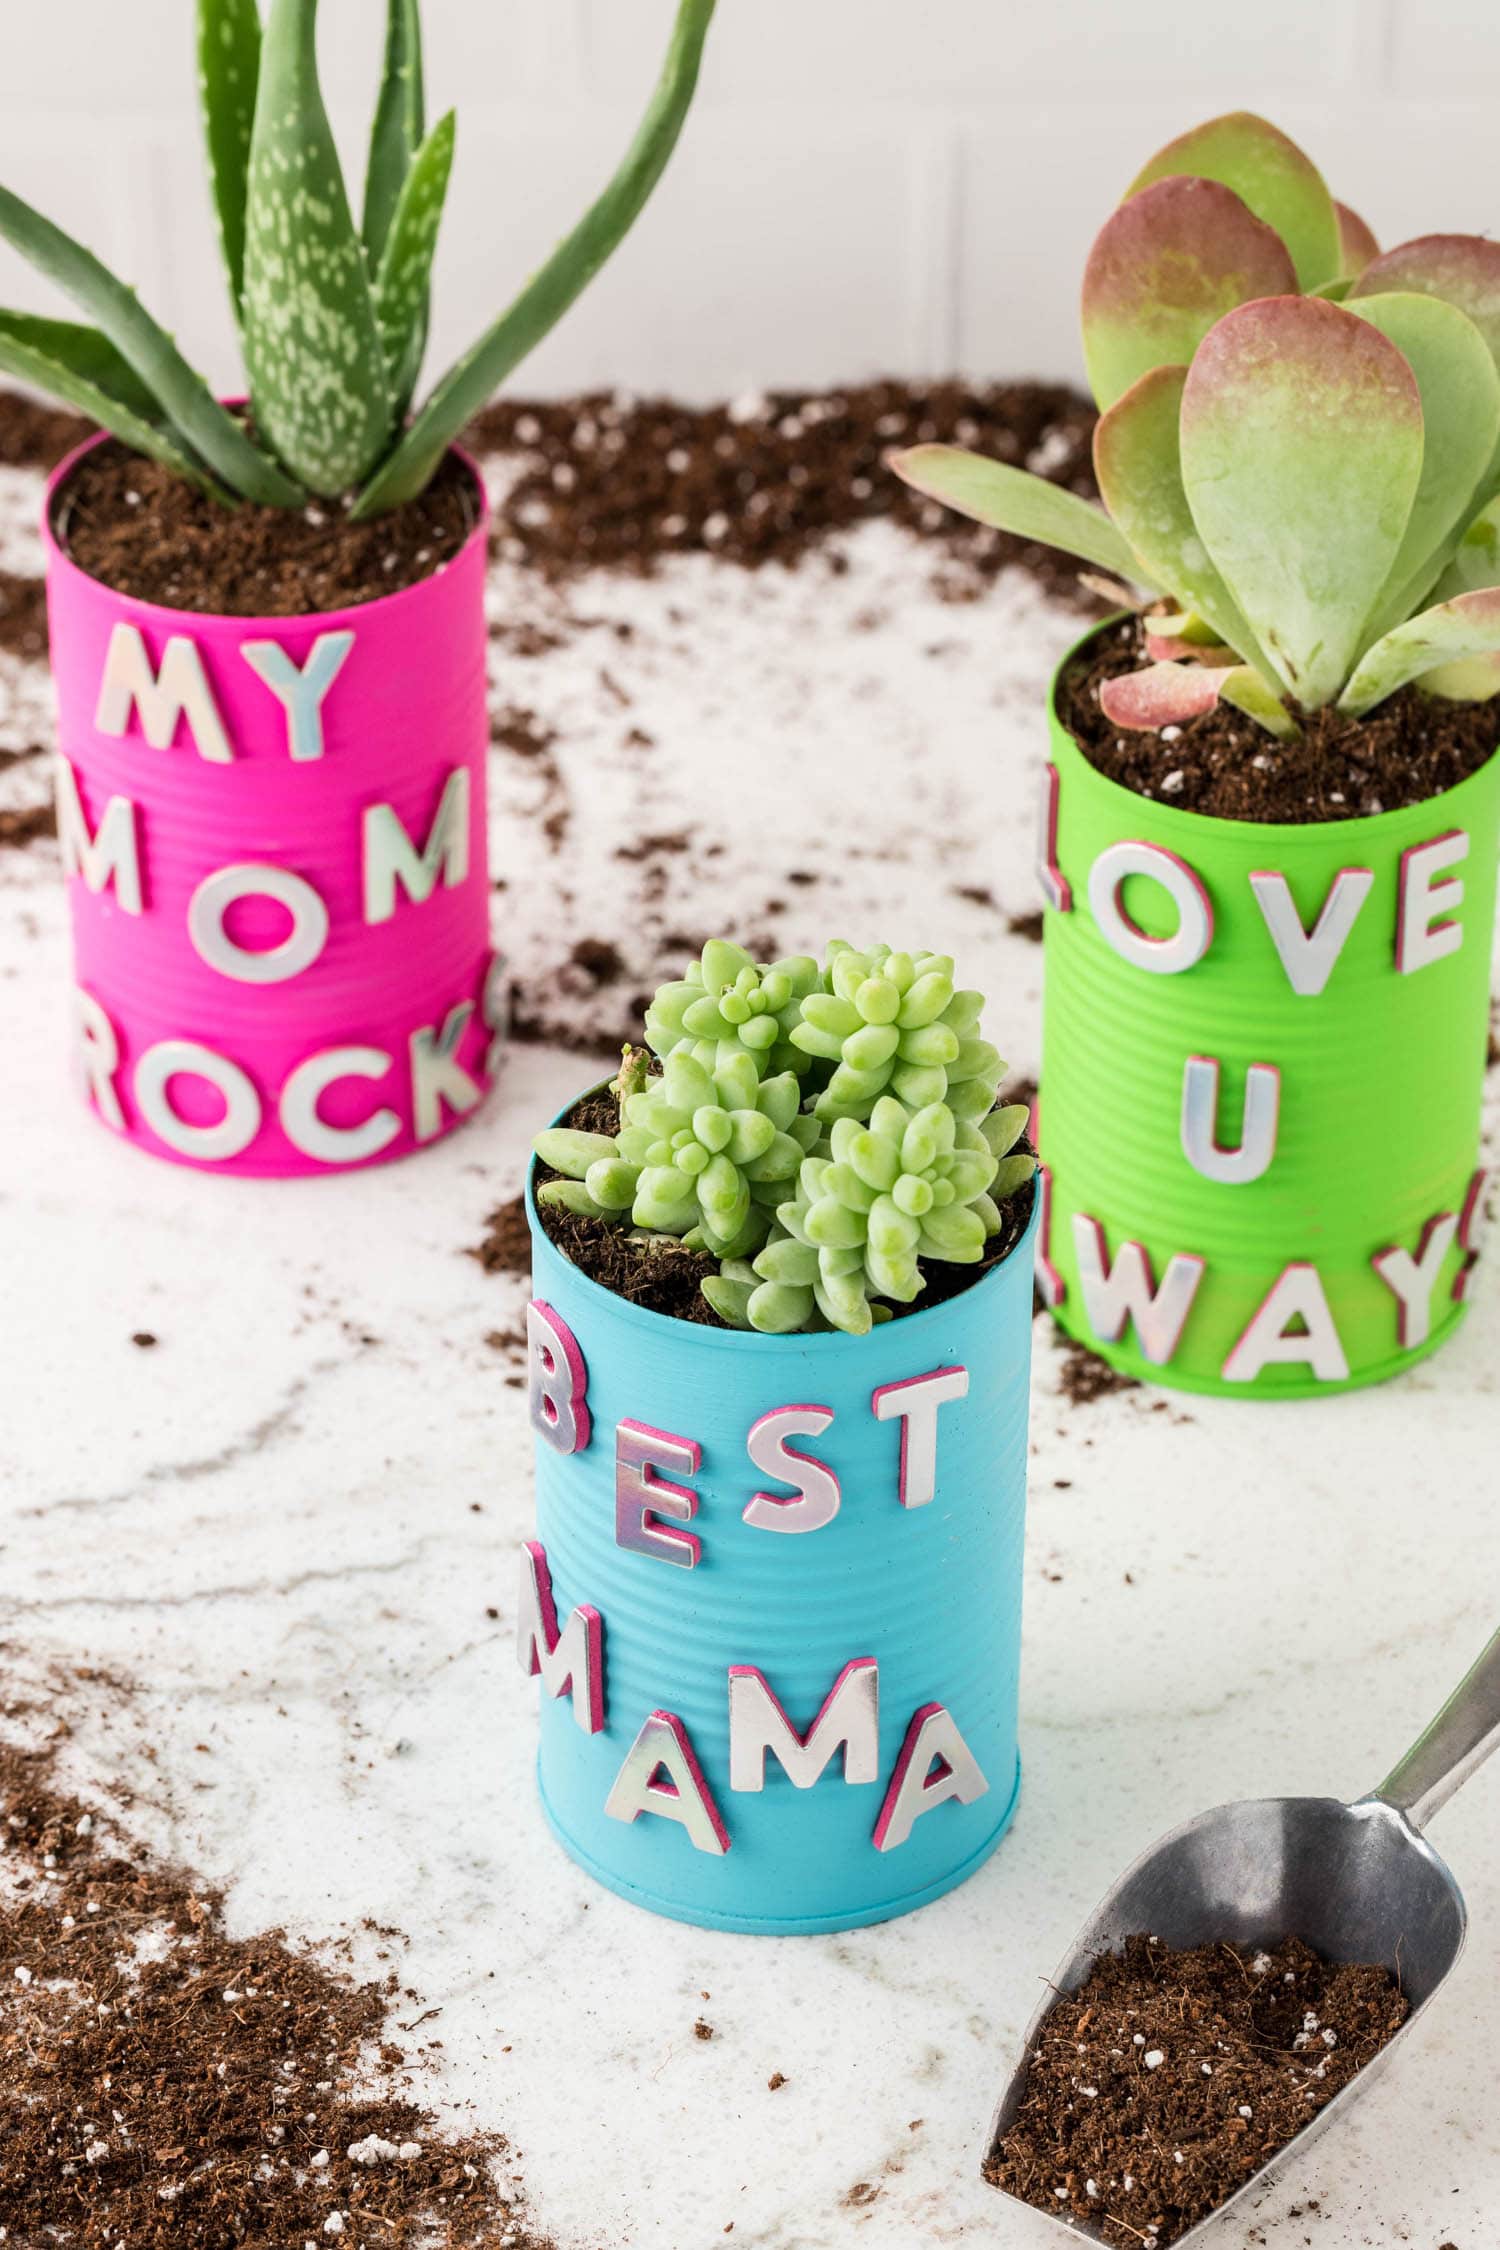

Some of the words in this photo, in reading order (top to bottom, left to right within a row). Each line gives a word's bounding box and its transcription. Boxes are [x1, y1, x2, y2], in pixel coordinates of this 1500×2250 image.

[95, 621, 356, 763] MY
[54, 752, 471, 984] MOM
[1036, 761, 1470, 995] LOVE
[1180, 1055, 1281, 1184] U
[527, 1298, 970, 1570] BEST
[516, 1541, 990, 1856] MAMA
